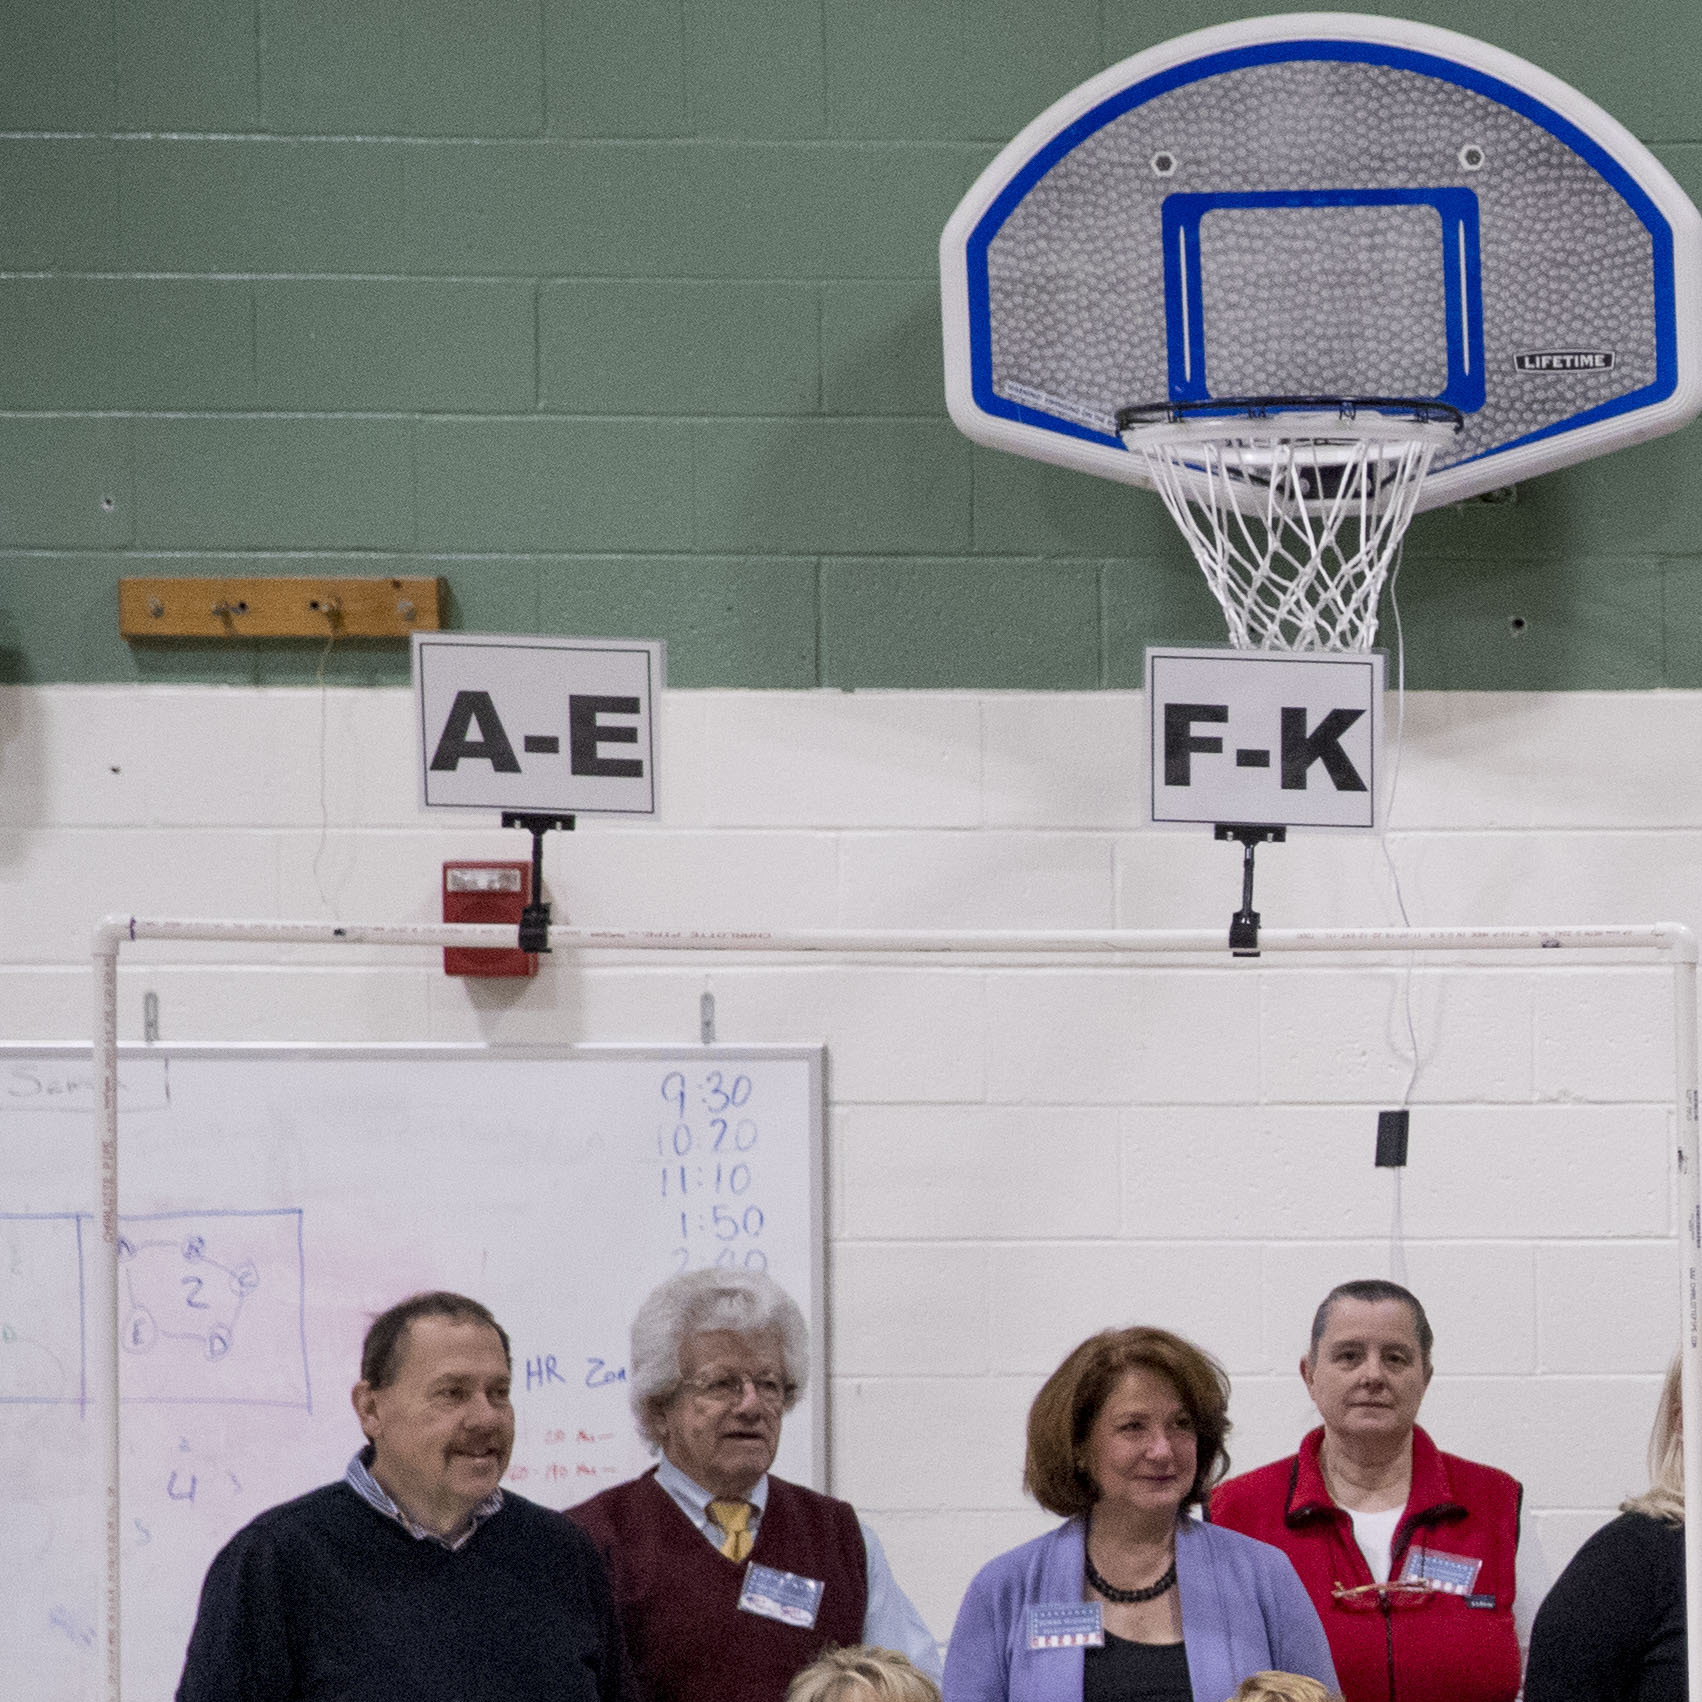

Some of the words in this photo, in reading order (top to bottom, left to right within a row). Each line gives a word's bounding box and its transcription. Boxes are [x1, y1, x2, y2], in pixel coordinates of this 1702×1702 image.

[1524, 354, 1606, 369] LIFETIME
[430, 691, 643, 777] A-E
[1164, 703, 1367, 791] F-K
[661, 1070, 752, 1118] 9:30
[660, 1163, 752, 1196] 11:10
[680, 1204, 765, 1241] 1:50
[526, 1354, 566, 1391] HR
